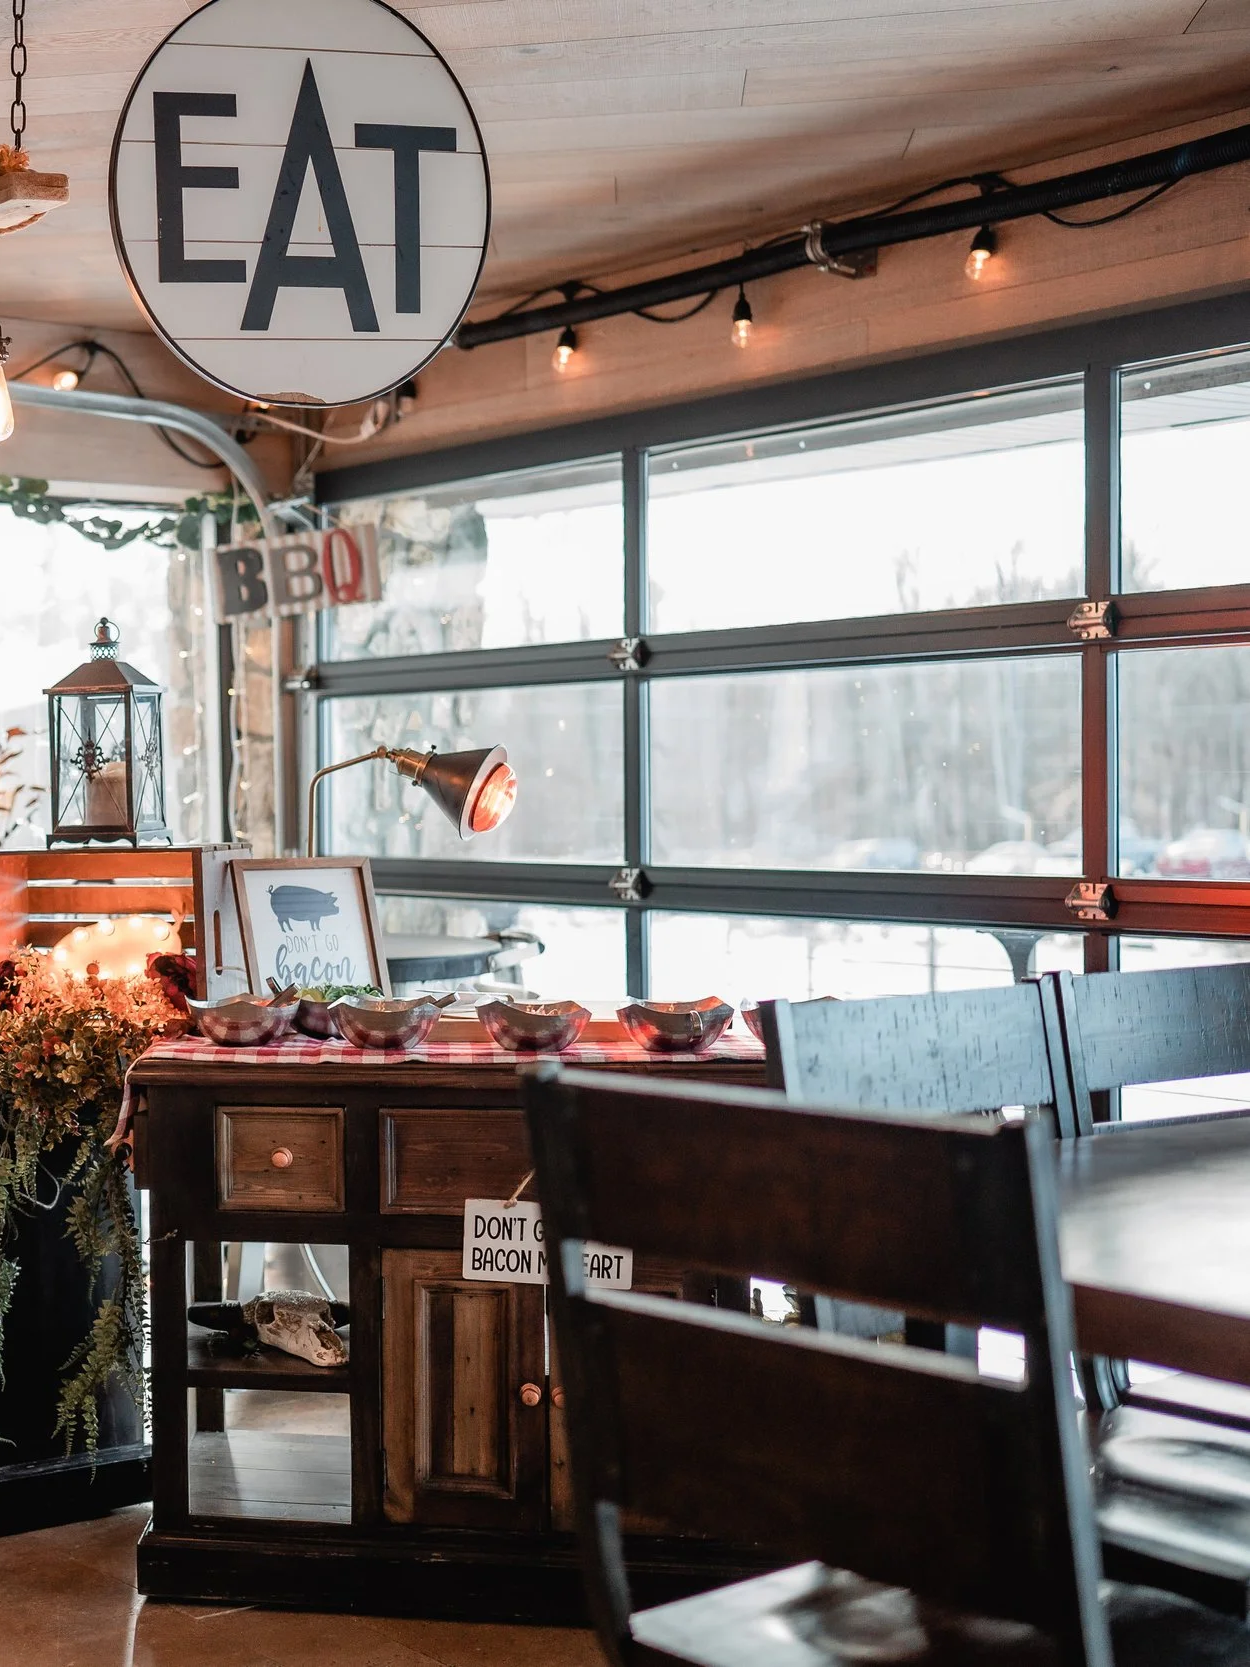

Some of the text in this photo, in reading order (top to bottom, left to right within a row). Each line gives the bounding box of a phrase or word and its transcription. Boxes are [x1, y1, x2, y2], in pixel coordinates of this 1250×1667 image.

[153, 58, 457, 332] EAT
[216, 528, 367, 616] BBQ
[285, 933, 339, 954] DON'T GO
[276, 944, 356, 989] bacon
[474, 1215, 545, 1242] DON'T G
[472, 1247, 531, 1274] BACON
[582, 1252, 624, 1280] EART
